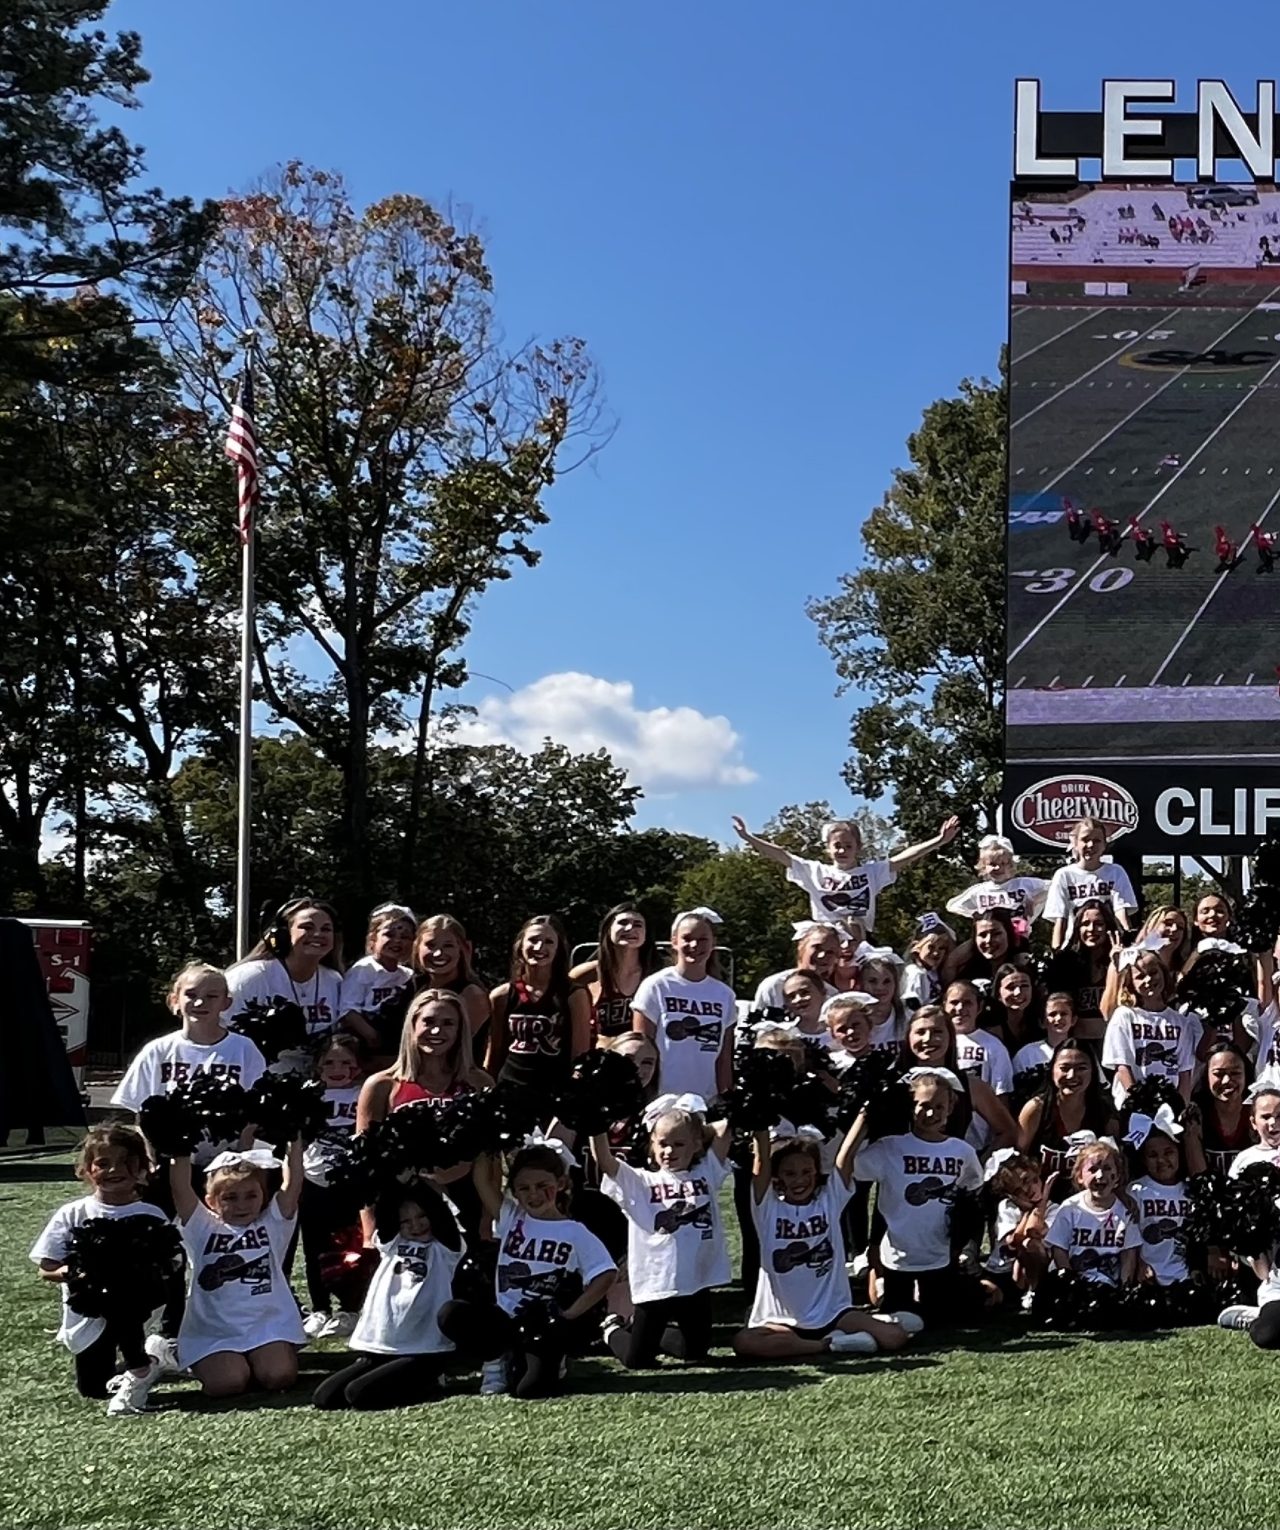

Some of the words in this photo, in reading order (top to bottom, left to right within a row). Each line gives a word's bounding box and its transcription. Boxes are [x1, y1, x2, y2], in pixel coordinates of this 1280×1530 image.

[1024, 567, 1135, 593] 30
[1014, 792, 1136, 828] Cheerwine
[50, 955, 81, 967] S-1
[664, 997, 723, 1018] BEARS
[509, 1014, 562, 1056] LR
[1143, 1198, 1193, 1218] BEAR
